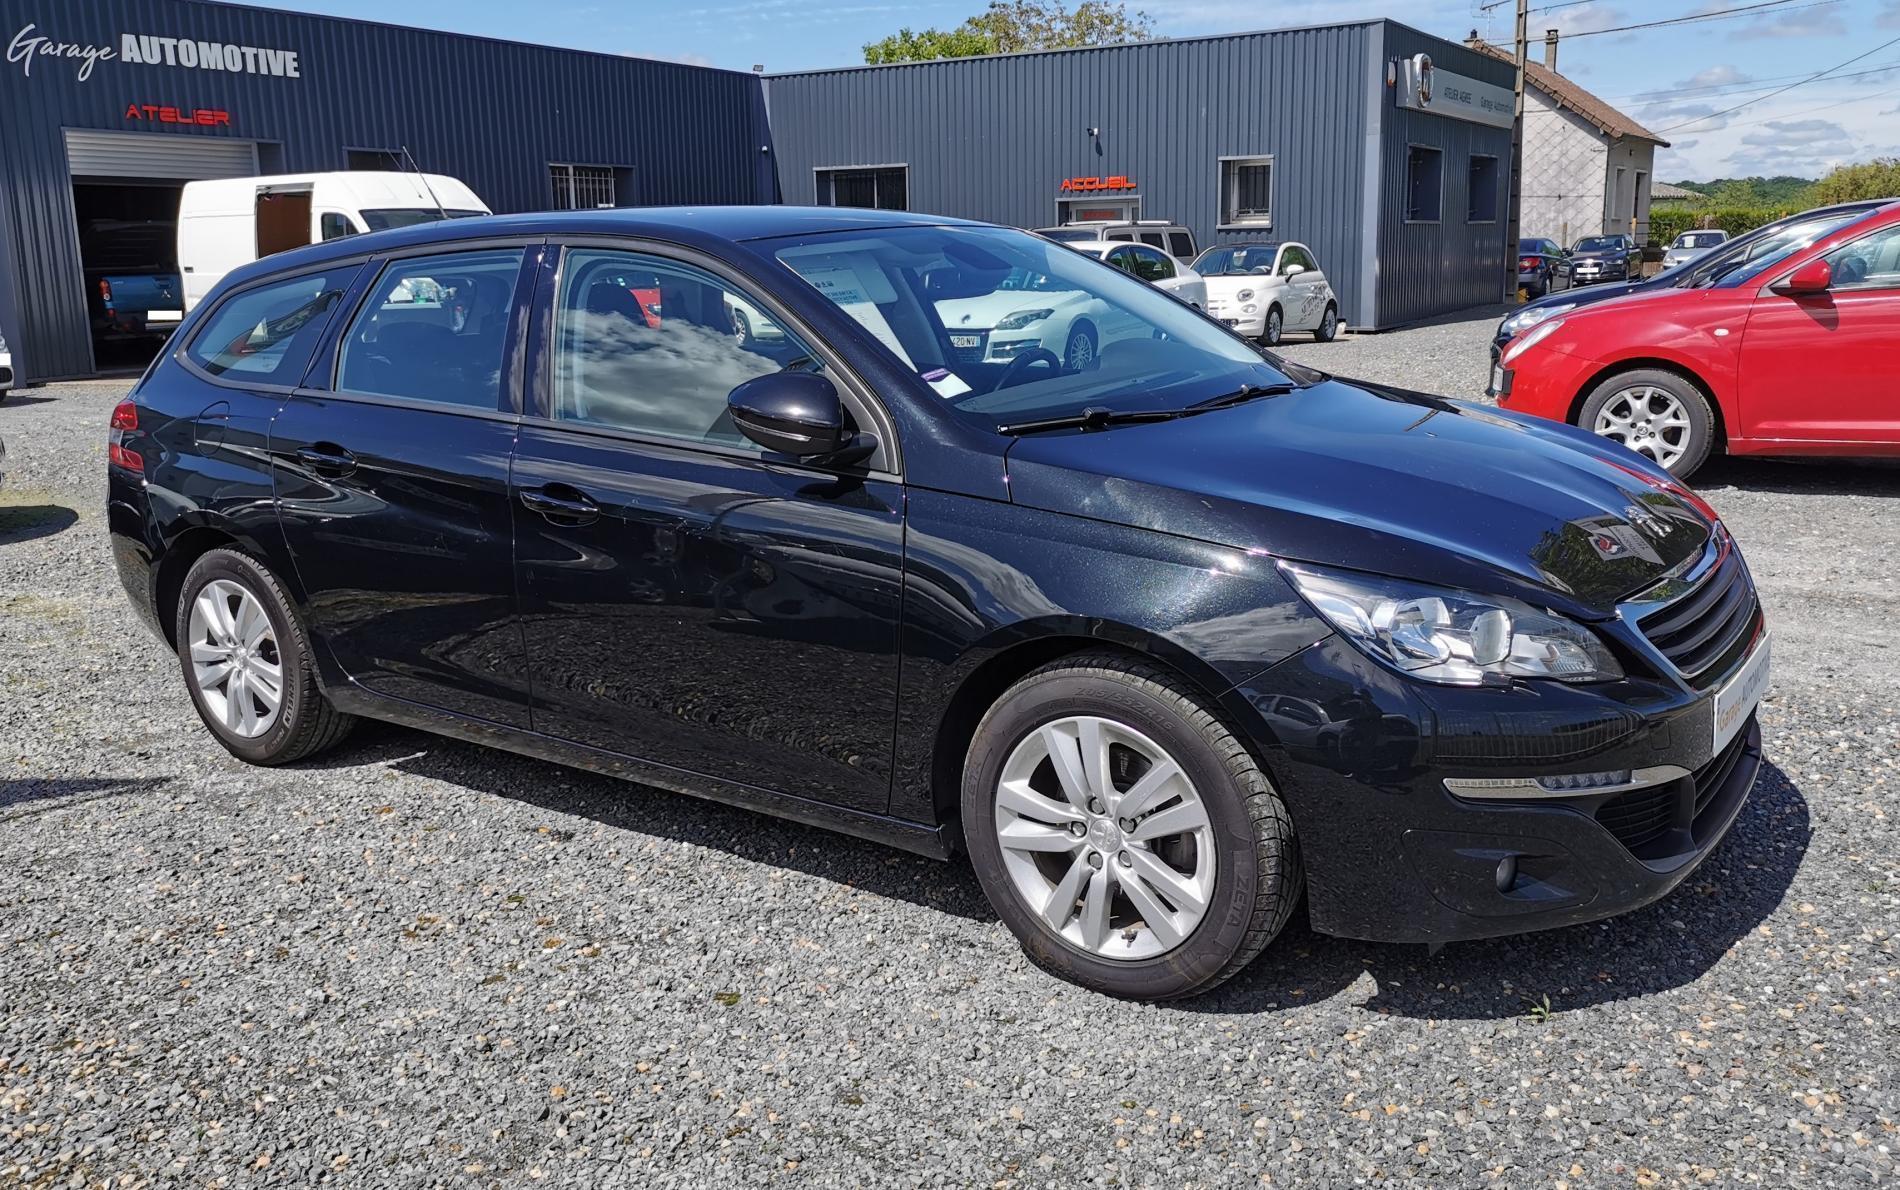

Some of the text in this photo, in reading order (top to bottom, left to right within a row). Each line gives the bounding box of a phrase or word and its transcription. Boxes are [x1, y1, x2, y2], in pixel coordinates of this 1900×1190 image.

[6, 23, 300, 82] Garage AUTOMOTIVE
[125, 104, 230, 126] ATELIER
[1060, 175, 1137, 193] ACCUEIL
